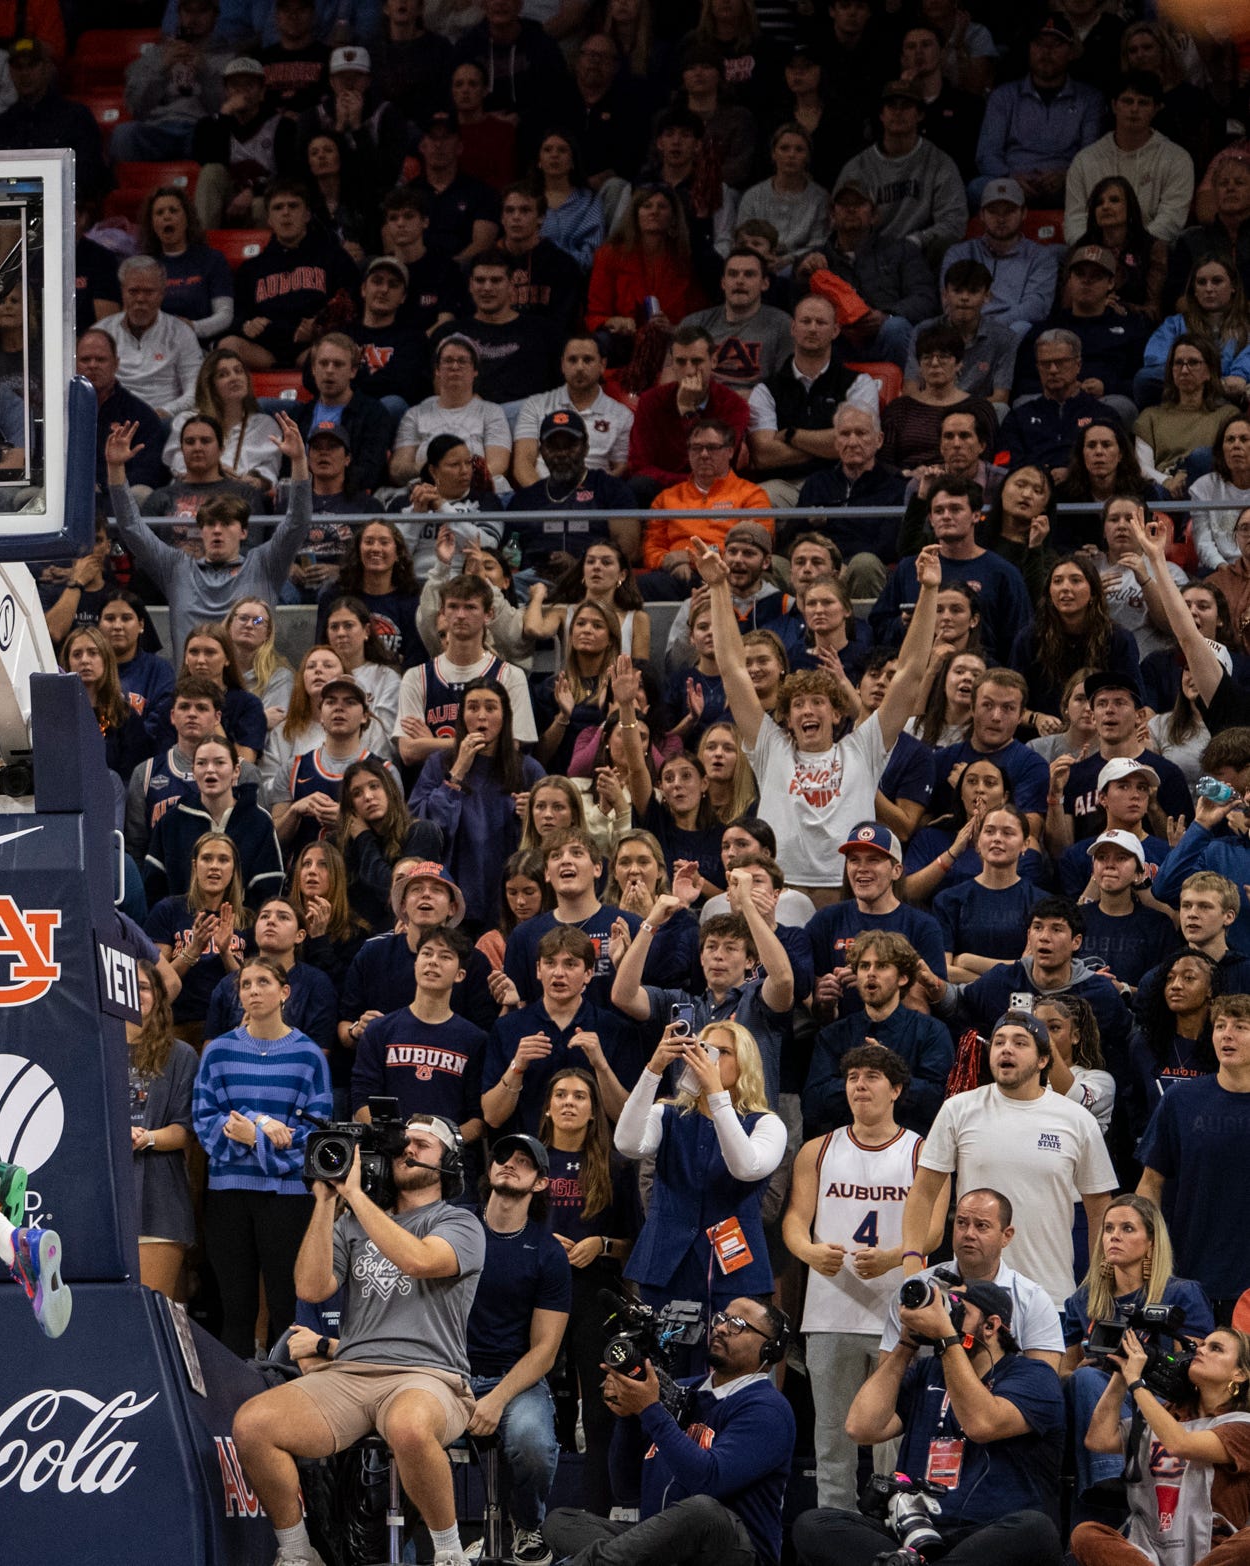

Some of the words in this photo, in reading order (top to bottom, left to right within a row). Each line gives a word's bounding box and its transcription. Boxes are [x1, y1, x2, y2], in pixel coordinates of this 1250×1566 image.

[256, 266, 327, 304] AUBURN
[427, 702, 460, 724] AUB
[100, 943, 139, 1012] YETI
[386, 1046, 469, 1075] AUBURN
[1038, 1141, 1061, 1150] STATE
[1041, 1133, 1060, 1142] PATE
[852, 1211, 878, 1248] 4
